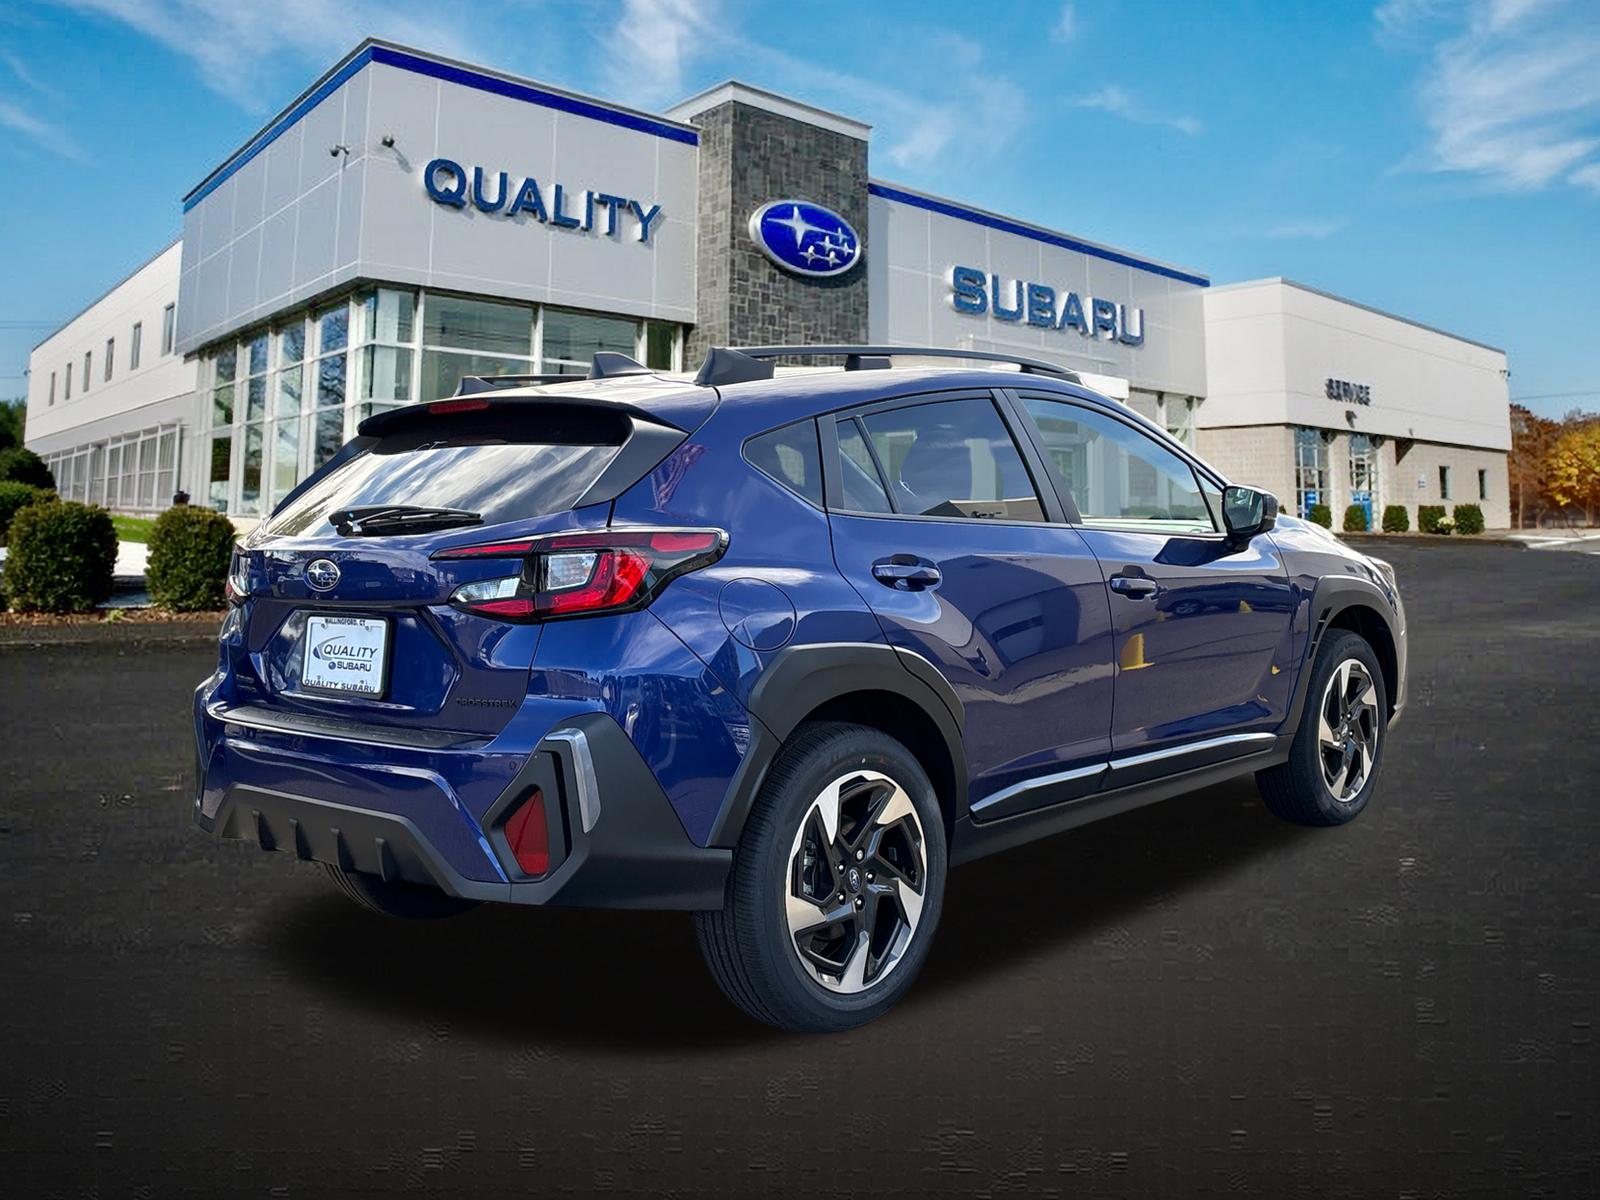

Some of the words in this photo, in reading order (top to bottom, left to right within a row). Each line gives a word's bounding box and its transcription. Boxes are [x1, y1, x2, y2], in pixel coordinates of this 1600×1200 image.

[423, 158, 661, 242] QUALITY
[950, 266, 1144, 346] SUBARU
[1325, 378, 1370, 406] SERVICE
[323, 644, 377, 658] QUALITY
[337, 661, 372, 672] SUBARU
[304, 679, 339, 688] QUALITY
[341, 682, 376, 692] SUBARU
